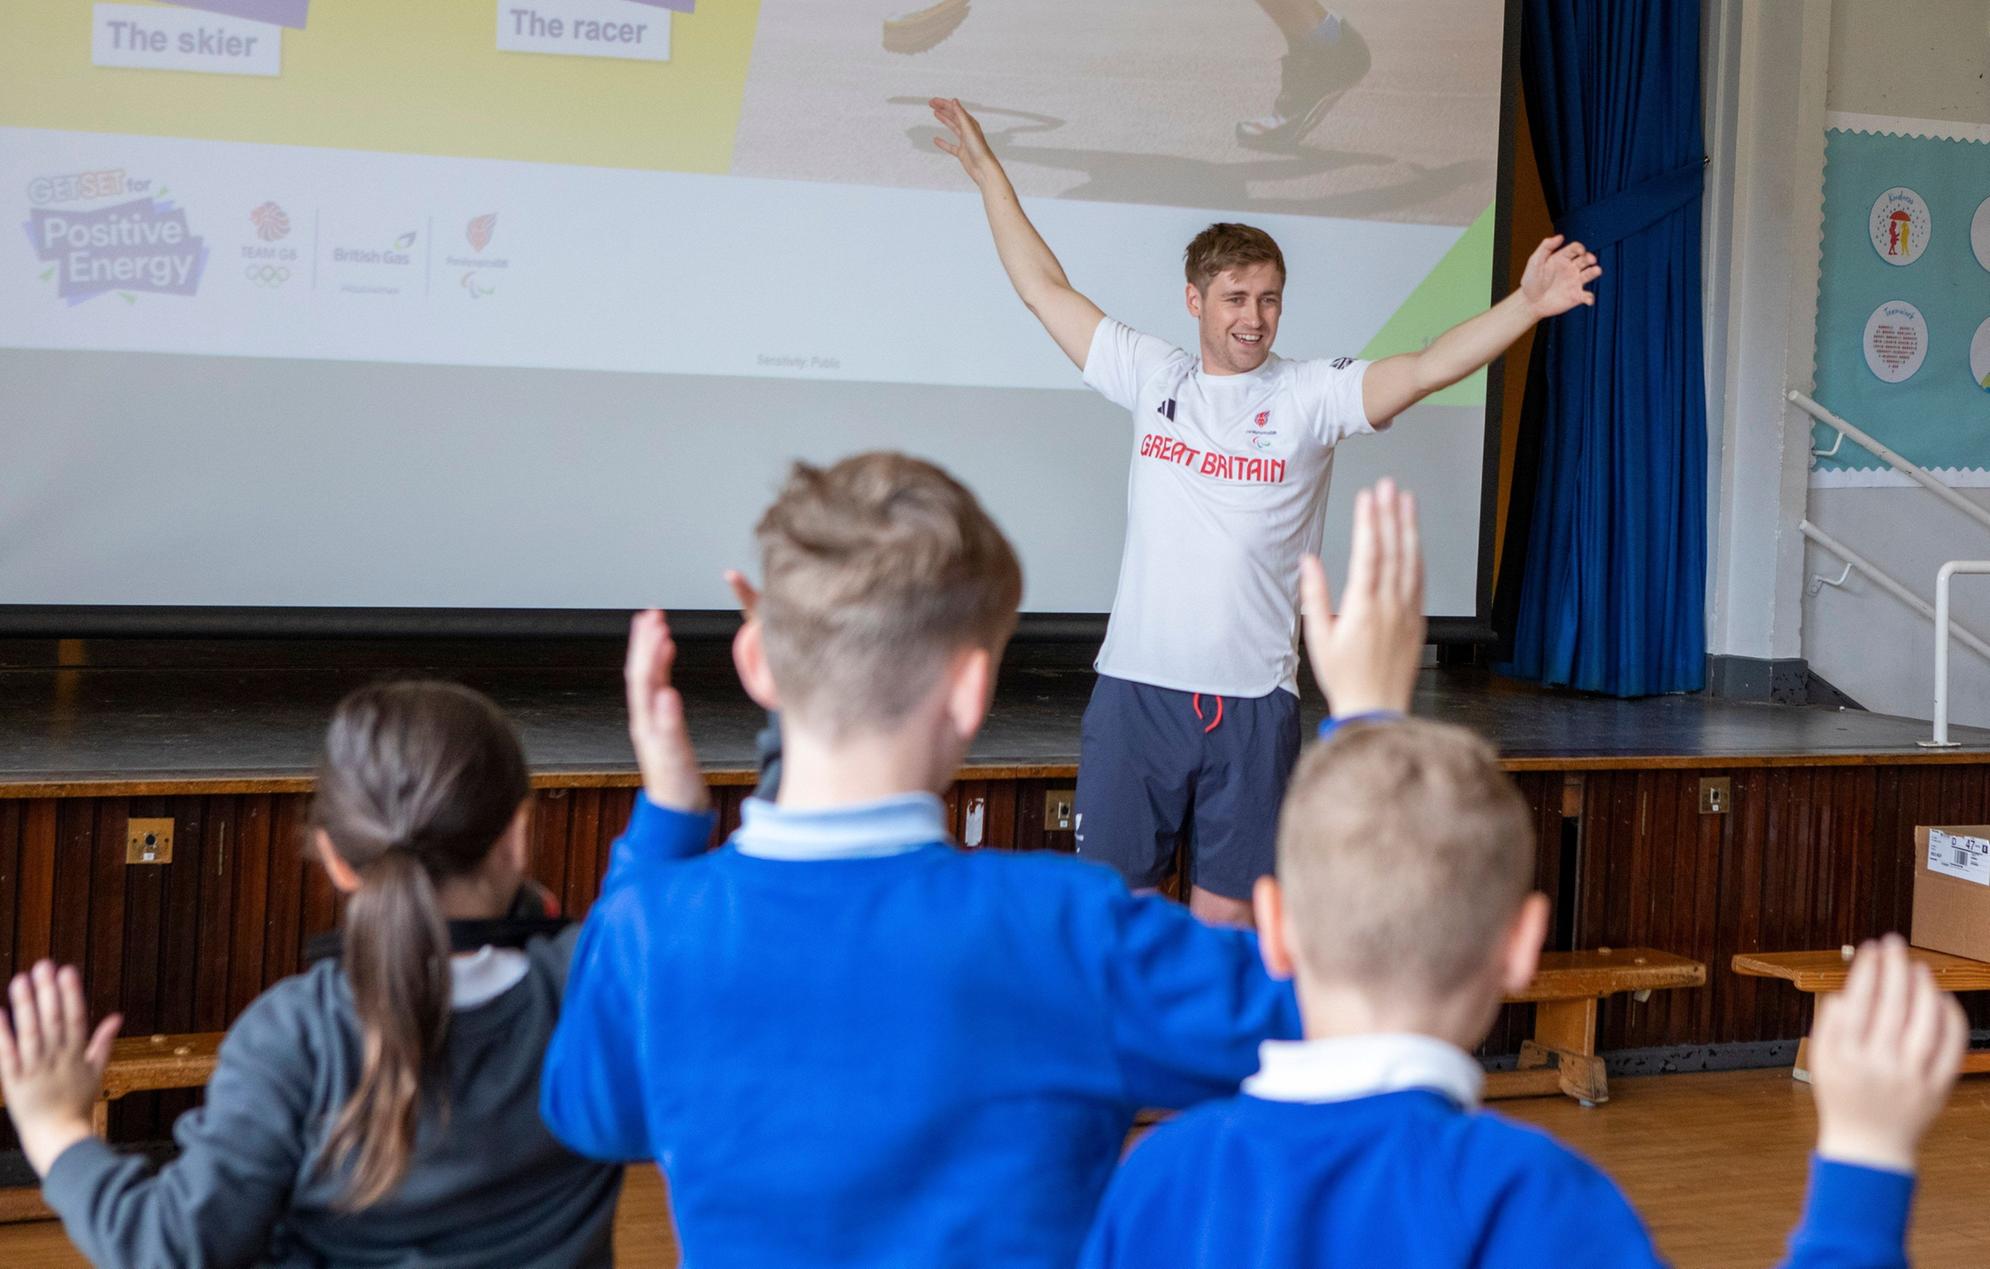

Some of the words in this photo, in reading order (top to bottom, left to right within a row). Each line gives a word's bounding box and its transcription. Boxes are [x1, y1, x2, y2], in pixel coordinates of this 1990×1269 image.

[106, 20, 168, 52] The
[177, 27, 259, 57] skier
[509, 8, 564, 38] The
[573, 19, 647, 44] racer
[126, 177, 152, 193] for
[44, 213, 183, 248] Positive
[69, 252, 193, 286] Energy
[240, 246, 276, 260] TEAM
[333, 247, 381, 264] British
[382, 249, 411, 265] Gas
[1140, 433, 1200, 467] GREAT
[1200, 451, 1286, 483] BRITAIN
